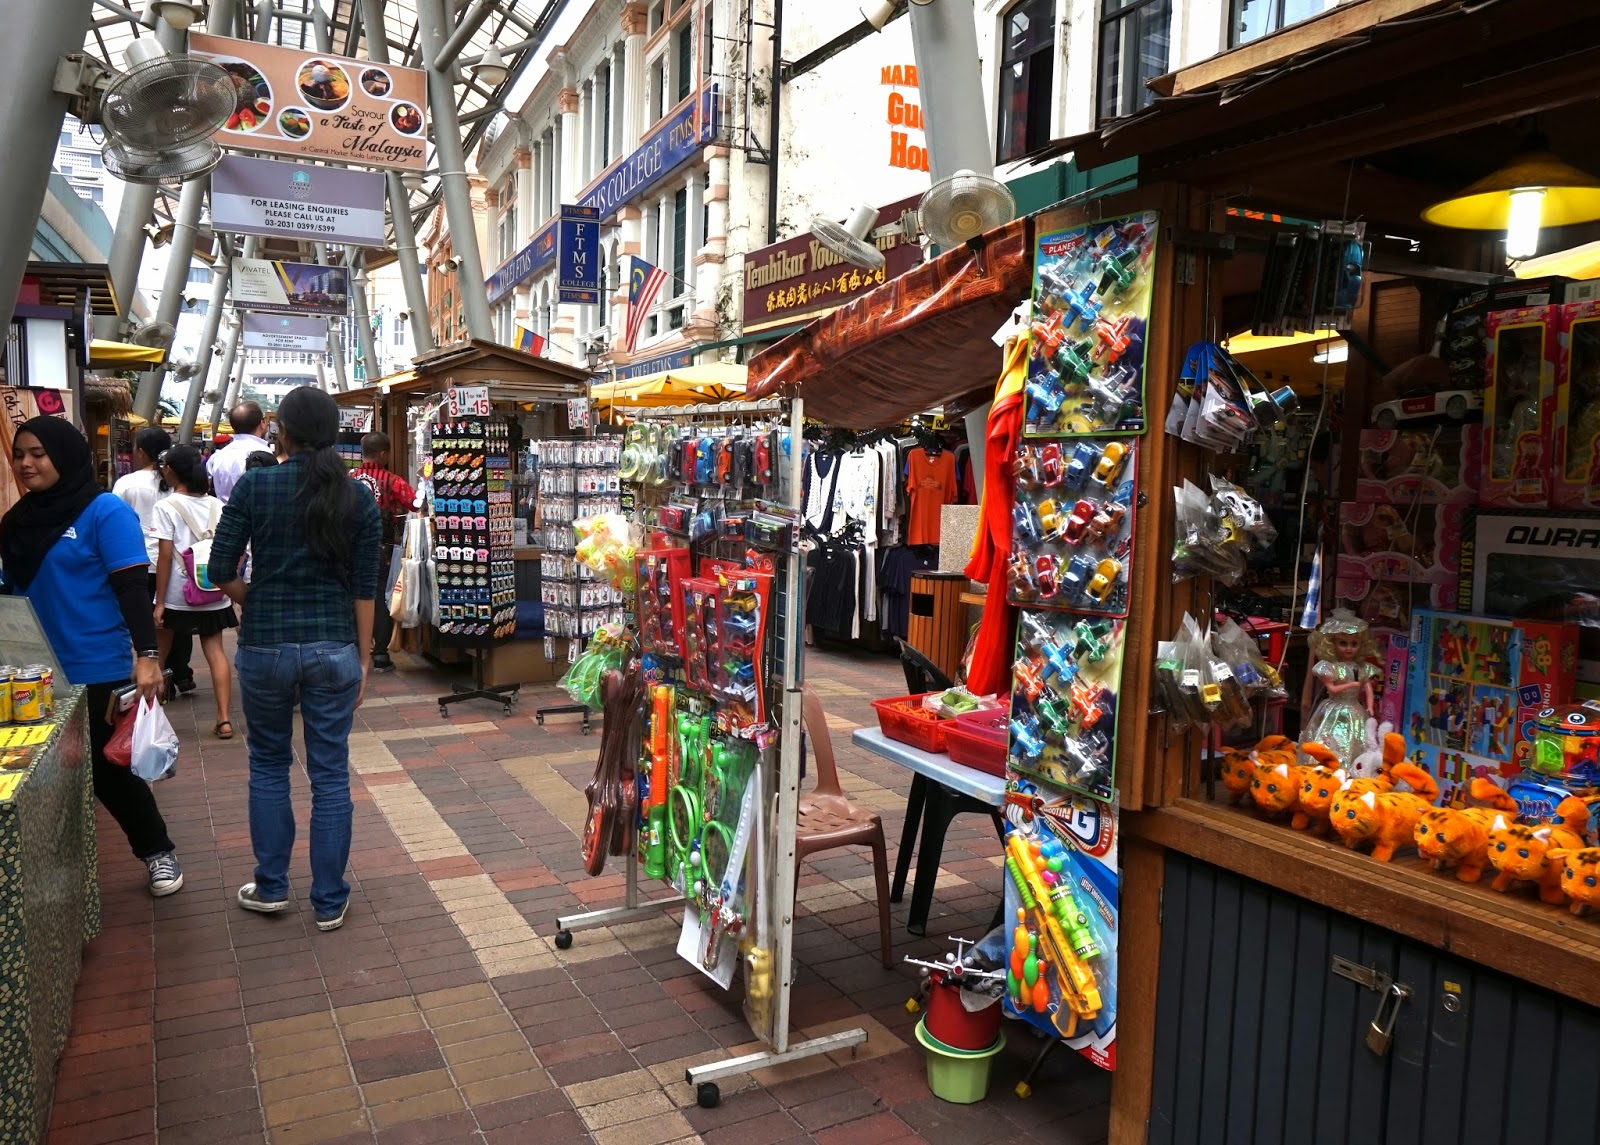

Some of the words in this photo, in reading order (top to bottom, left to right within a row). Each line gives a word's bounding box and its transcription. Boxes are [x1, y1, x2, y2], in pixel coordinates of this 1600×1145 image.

[881, 65, 918, 87] MAR
[352, 105, 385, 120] Savour
[321, 118, 329, 126] a
[332, 115, 365, 131] Taste
[369, 122, 386, 136] of
[309, 146, 329, 154] Central
[331, 149, 348, 157] Market
[367, 153, 385, 161] Lumpur
[343, 136, 423, 162] Malaysia
[608, 138, 662, 206] COLLEGE
[251, 199, 267, 207] FOR
[270, 201, 305, 211] LEASING
[308, 205, 348, 216] ENQUIRIES
[265, 210, 291, 218] PLEASE
[294, 213, 312, 221] CALL
[265, 219, 294, 229] 03-2031
[297, 222, 335, 232] 0399/5399
[1048, 242, 1076, 254] PLANES
[745, 250, 807, 290] Tembikar
[562, 280, 595, 288] COLLEGE
[450, 401, 458, 416] 3
[1460, 541, 1473, 573] TOYS
[15, 691, 30, 700] pton
